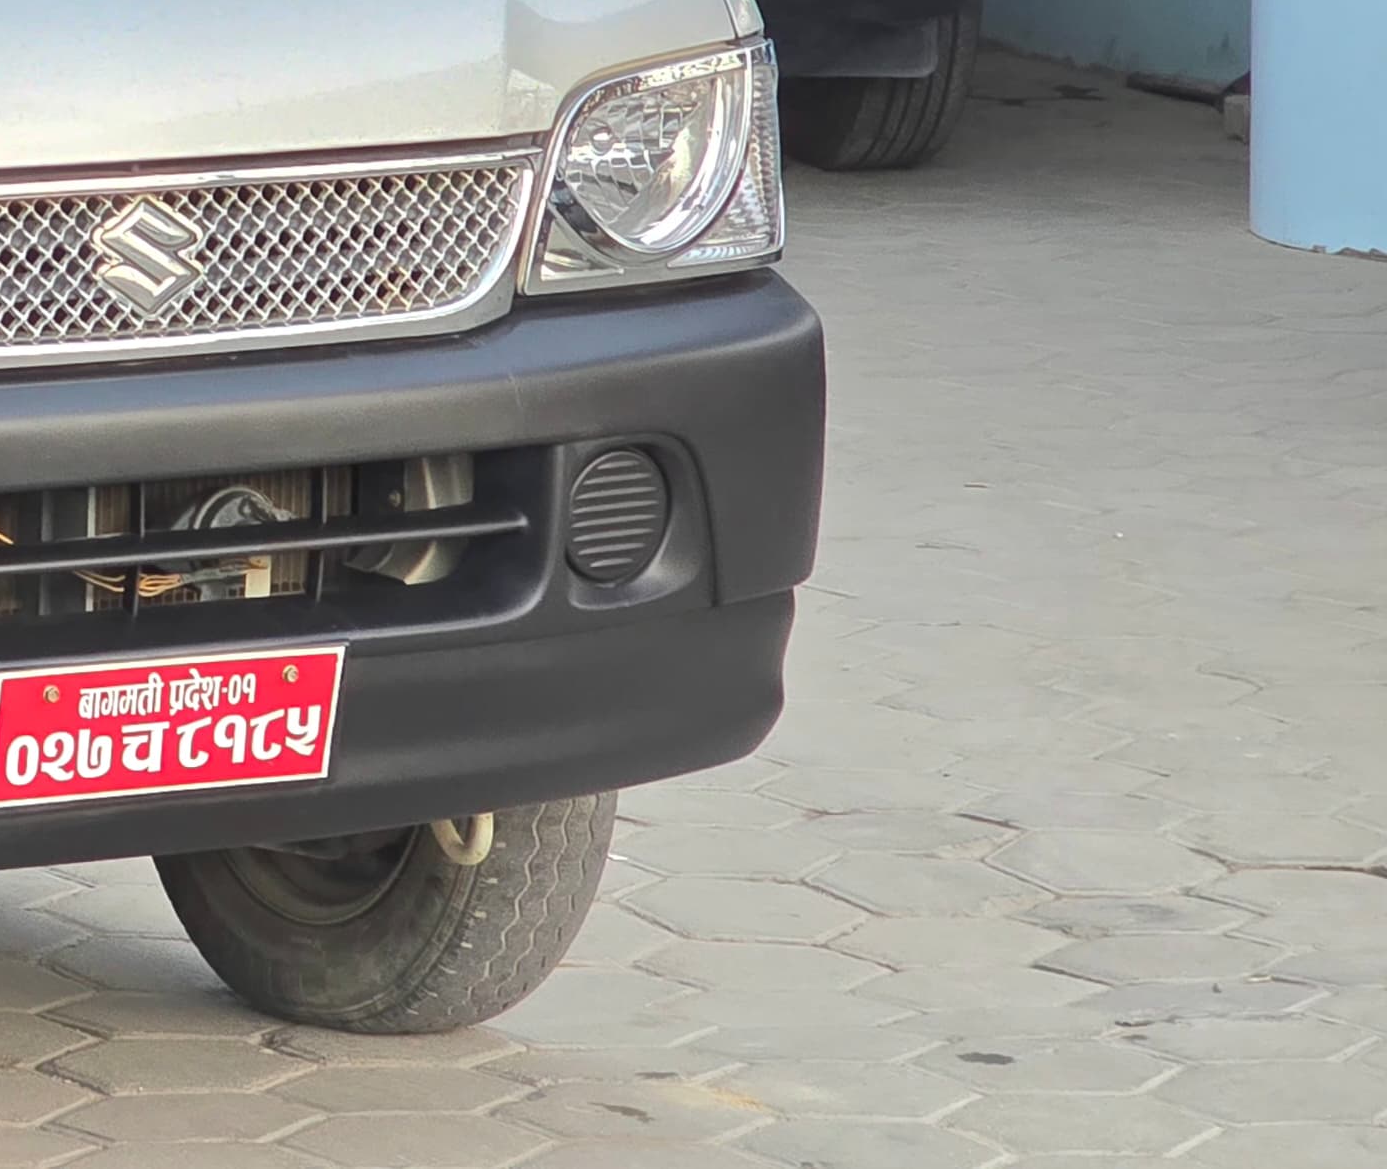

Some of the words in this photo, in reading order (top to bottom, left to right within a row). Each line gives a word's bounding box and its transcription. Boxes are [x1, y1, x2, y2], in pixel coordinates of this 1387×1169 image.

[78, 671, 165, 719] बागमती
[5, 728, 114, 786] ०२७
[121, 721, 170, 773] च
[176, 704, 321, 768] ८१८५
